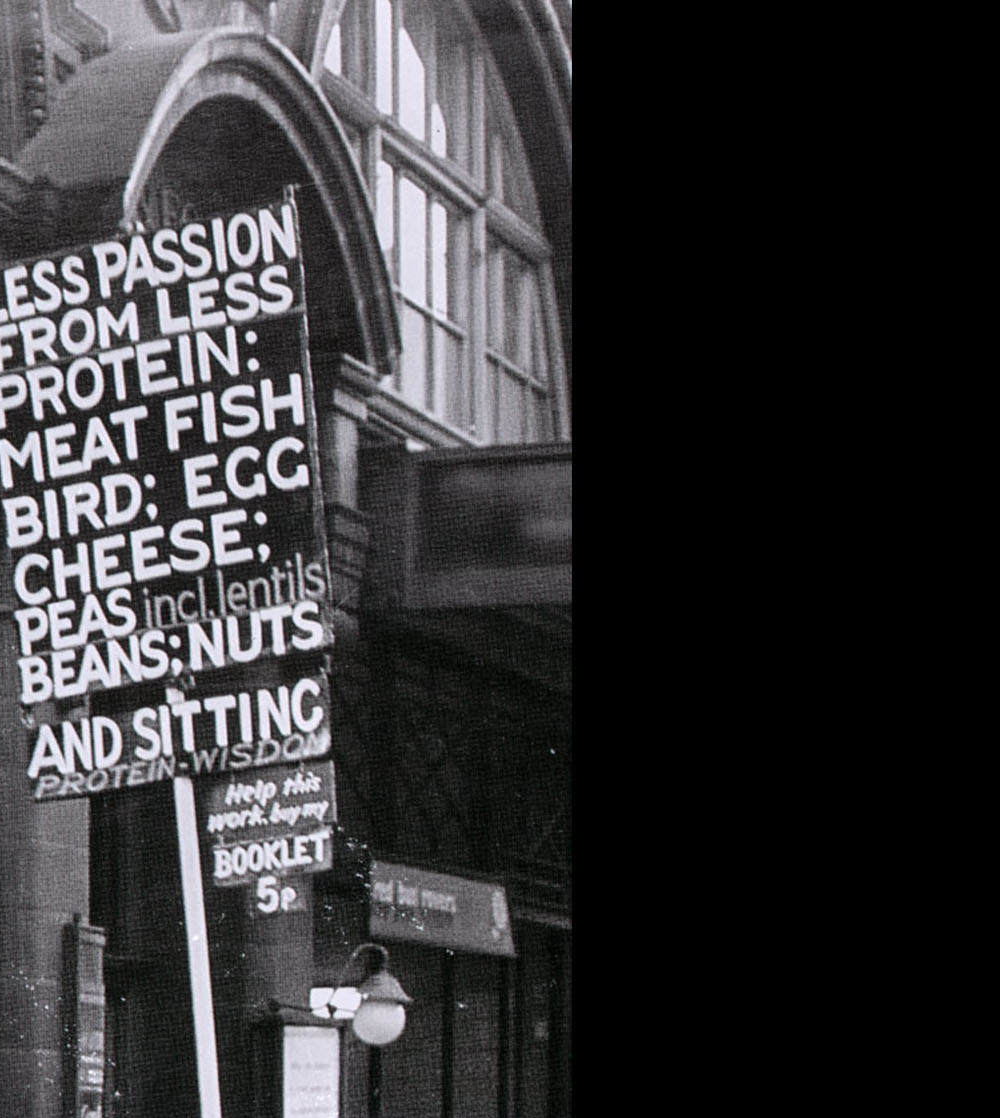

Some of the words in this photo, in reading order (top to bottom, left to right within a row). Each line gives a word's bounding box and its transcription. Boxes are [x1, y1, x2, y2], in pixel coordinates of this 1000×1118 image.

[93, 204, 297, 298] PASSION
[156, 265, 294, 335] LESS
[164, 373, 305, 451] FISH
[183, 436, 309, 509] EGG
[14, 588, 136, 655] PEAS
[215, 551, 326, 617] lentils
[188, 600, 324, 671] NUTS
[27, 715, 123, 778] AND
[225, 778, 276, 806] Help
[282, 771, 322, 796] this
[269, 801, 302, 826] buy
[301, 799, 329, 821] my
[213, 830, 333, 879] BOOKLET
